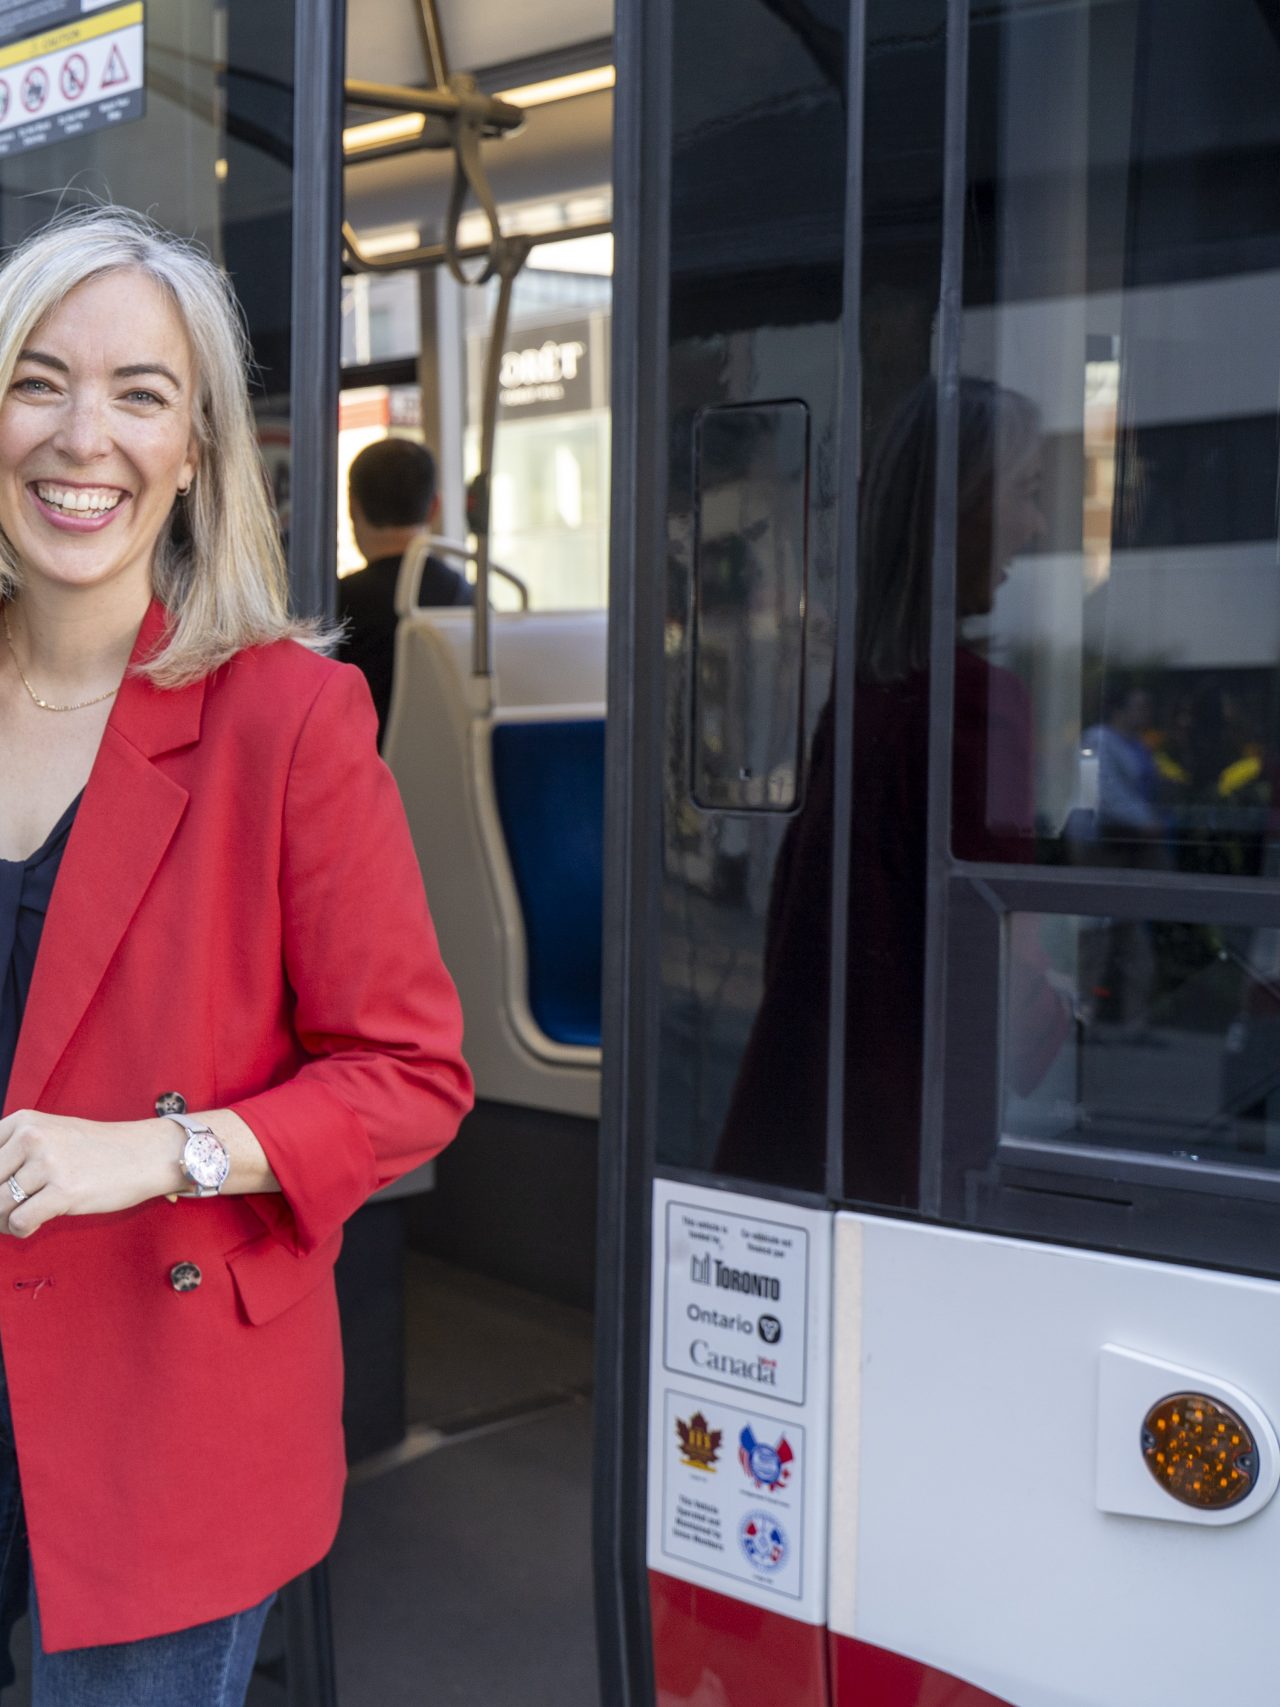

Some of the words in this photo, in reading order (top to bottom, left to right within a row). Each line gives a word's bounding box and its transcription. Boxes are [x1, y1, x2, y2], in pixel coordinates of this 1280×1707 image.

[714, 1258, 781, 1302] TORONTO
[686, 1303, 754, 1335] Ontario
[689, 1338, 777, 1386] Canada
